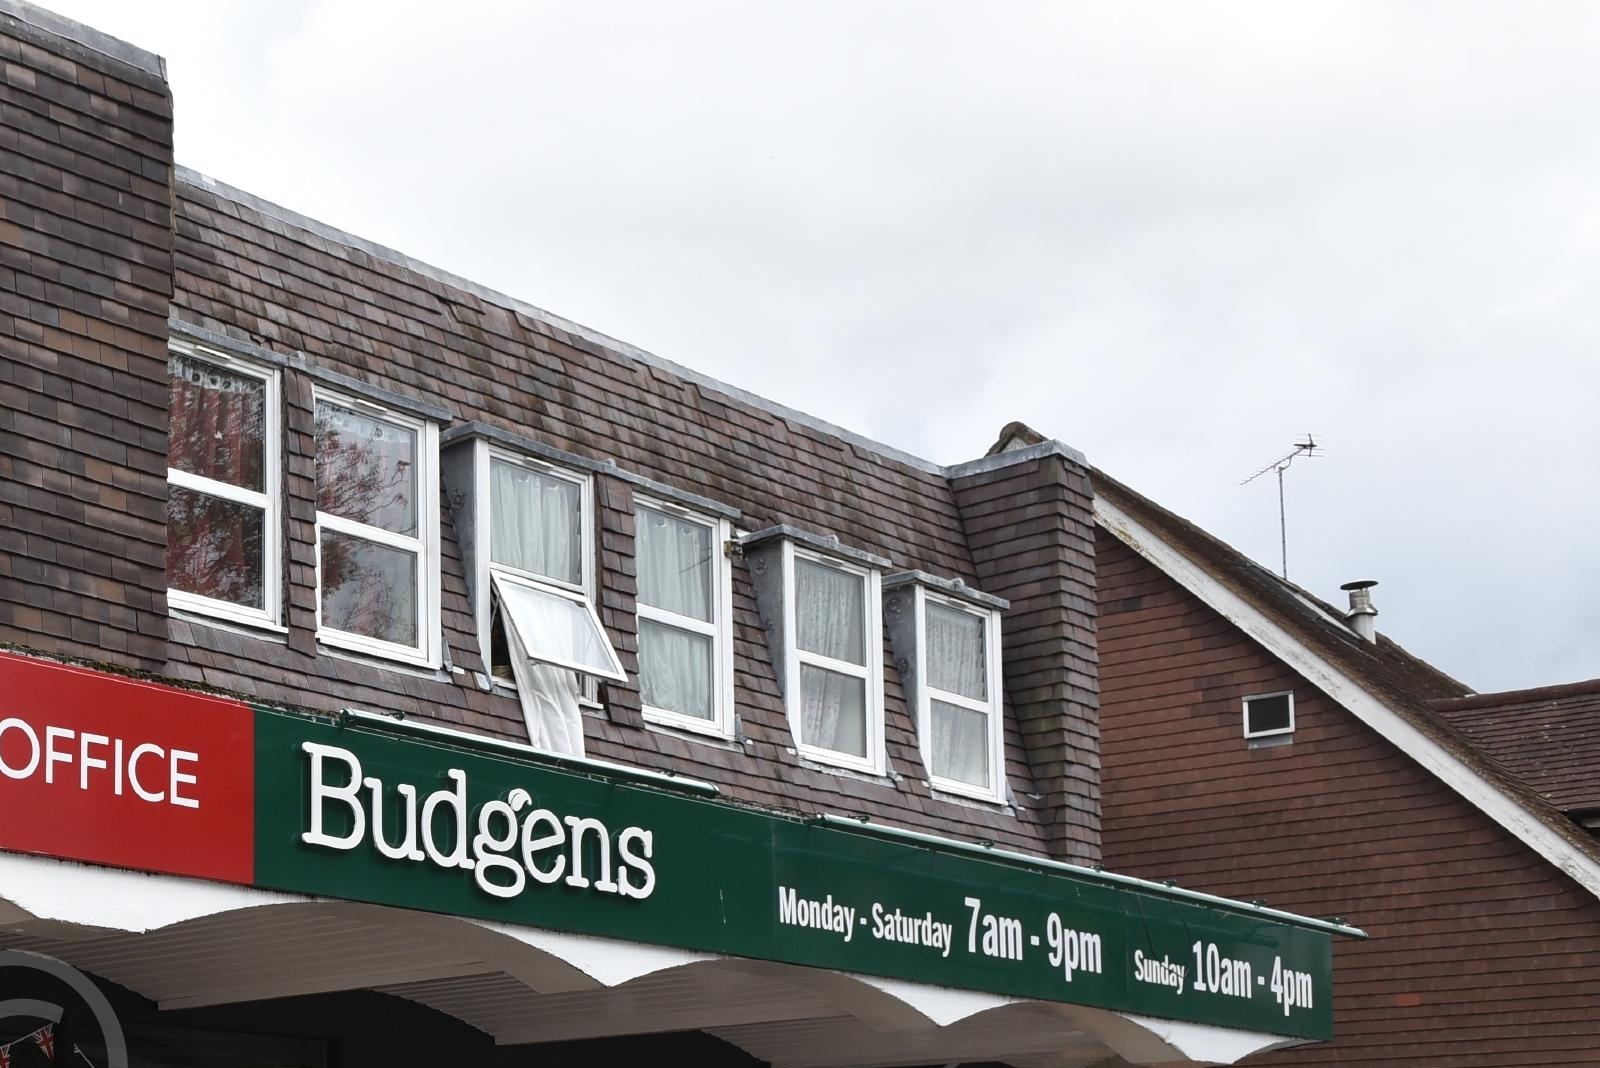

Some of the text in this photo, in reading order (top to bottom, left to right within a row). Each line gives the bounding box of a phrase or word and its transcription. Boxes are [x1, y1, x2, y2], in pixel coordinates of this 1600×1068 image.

[300, 741, 655, 898] Budgens
[779, 886, 856, 942] Monday
[872, 902, 953, 958] Saturday
[965, 897, 1023, 961] 7am
[1047, 912, 1102, 982] 9pm
[1134, 949, 1186, 995] Sunday
[1193, 940, 1252, 999] 10am
[1271, 956, 1313, 1017] 4pm
